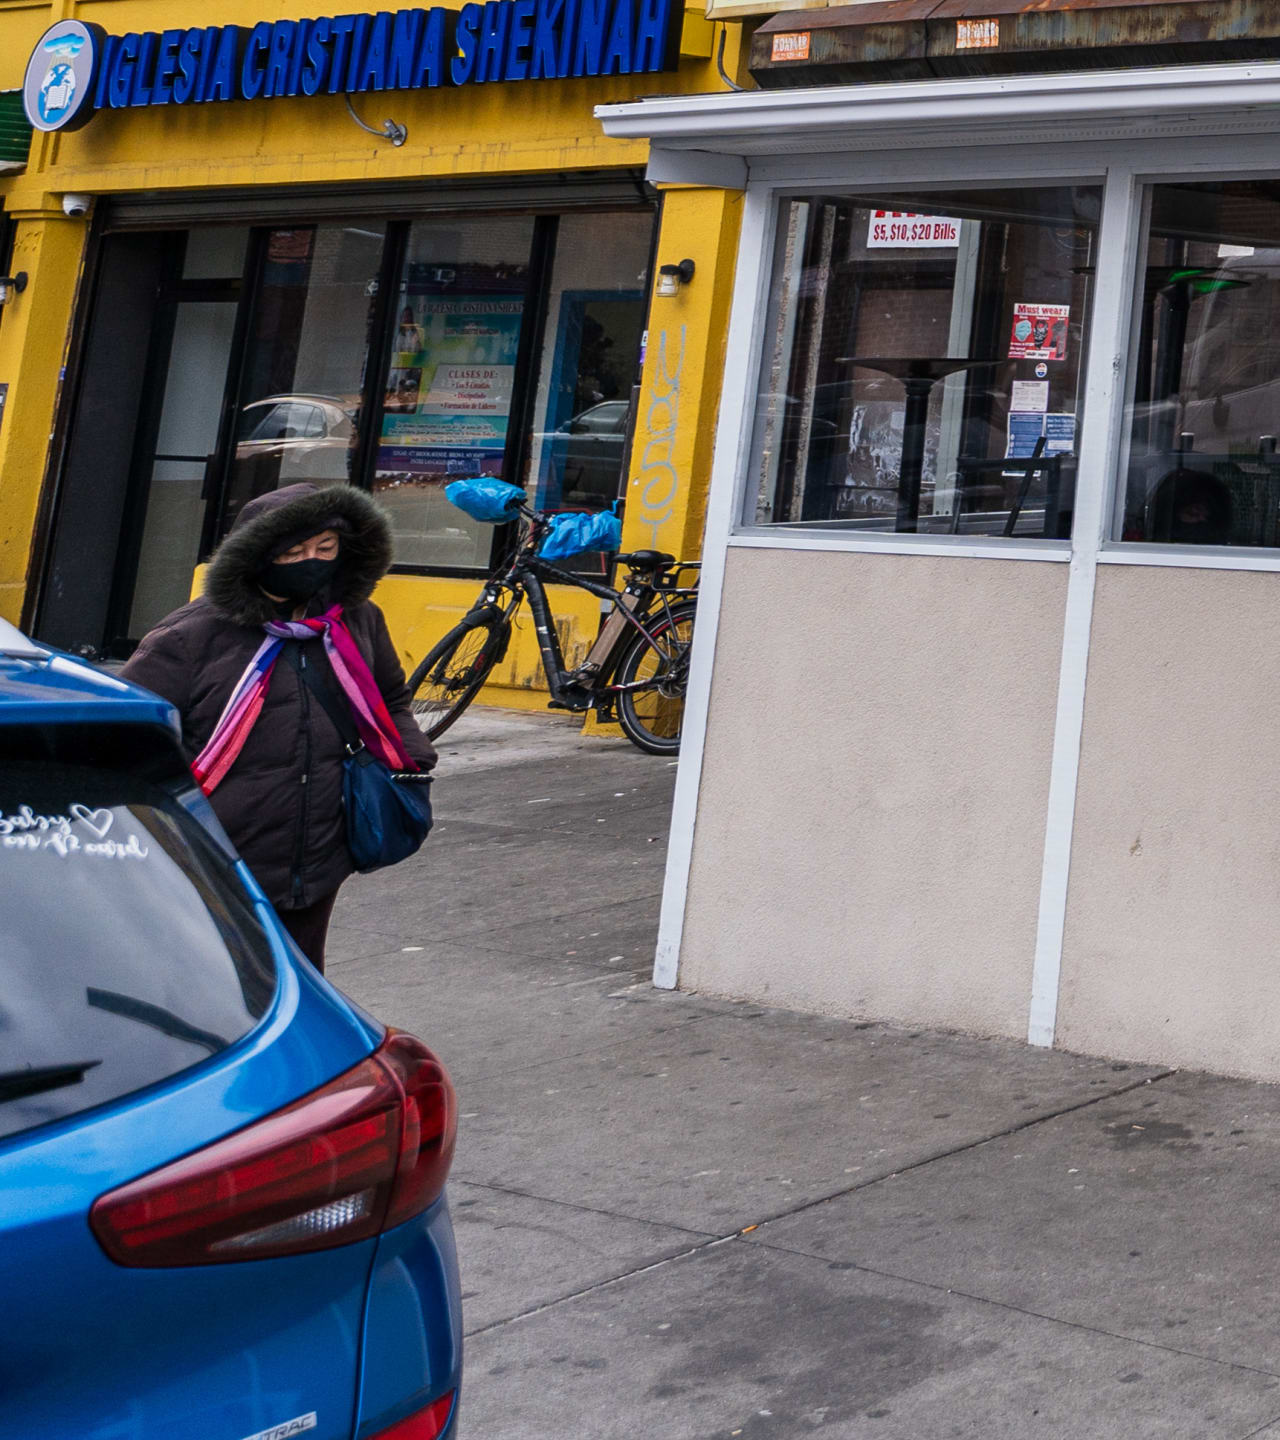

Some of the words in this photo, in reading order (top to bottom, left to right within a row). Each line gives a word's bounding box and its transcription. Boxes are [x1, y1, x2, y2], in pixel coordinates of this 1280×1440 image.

[94, 23, 243, 109] IGLESIA
[242, 5, 450, 99] CRISTIANA
[911, 222, 931, 241] $20
[933, 223, 956, 240] Bills
[262, 1414, 313, 1440] TRAC
